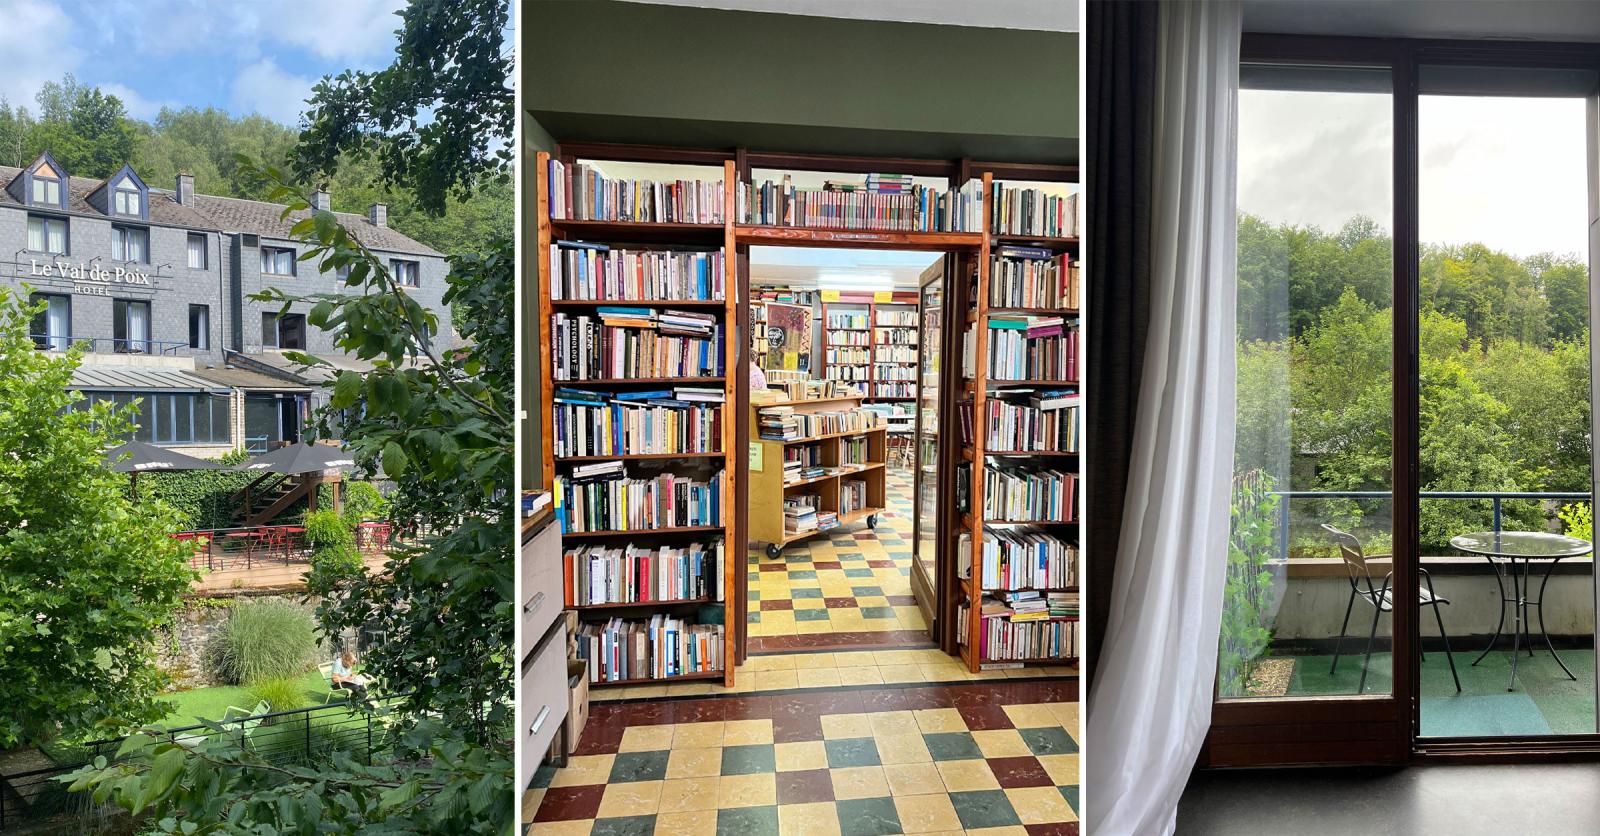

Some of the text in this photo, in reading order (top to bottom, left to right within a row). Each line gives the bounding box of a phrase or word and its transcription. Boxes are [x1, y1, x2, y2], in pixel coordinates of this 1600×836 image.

[30, 259, 150, 285] Le Val de Poix
[74, 285, 111, 296] HOTEL
